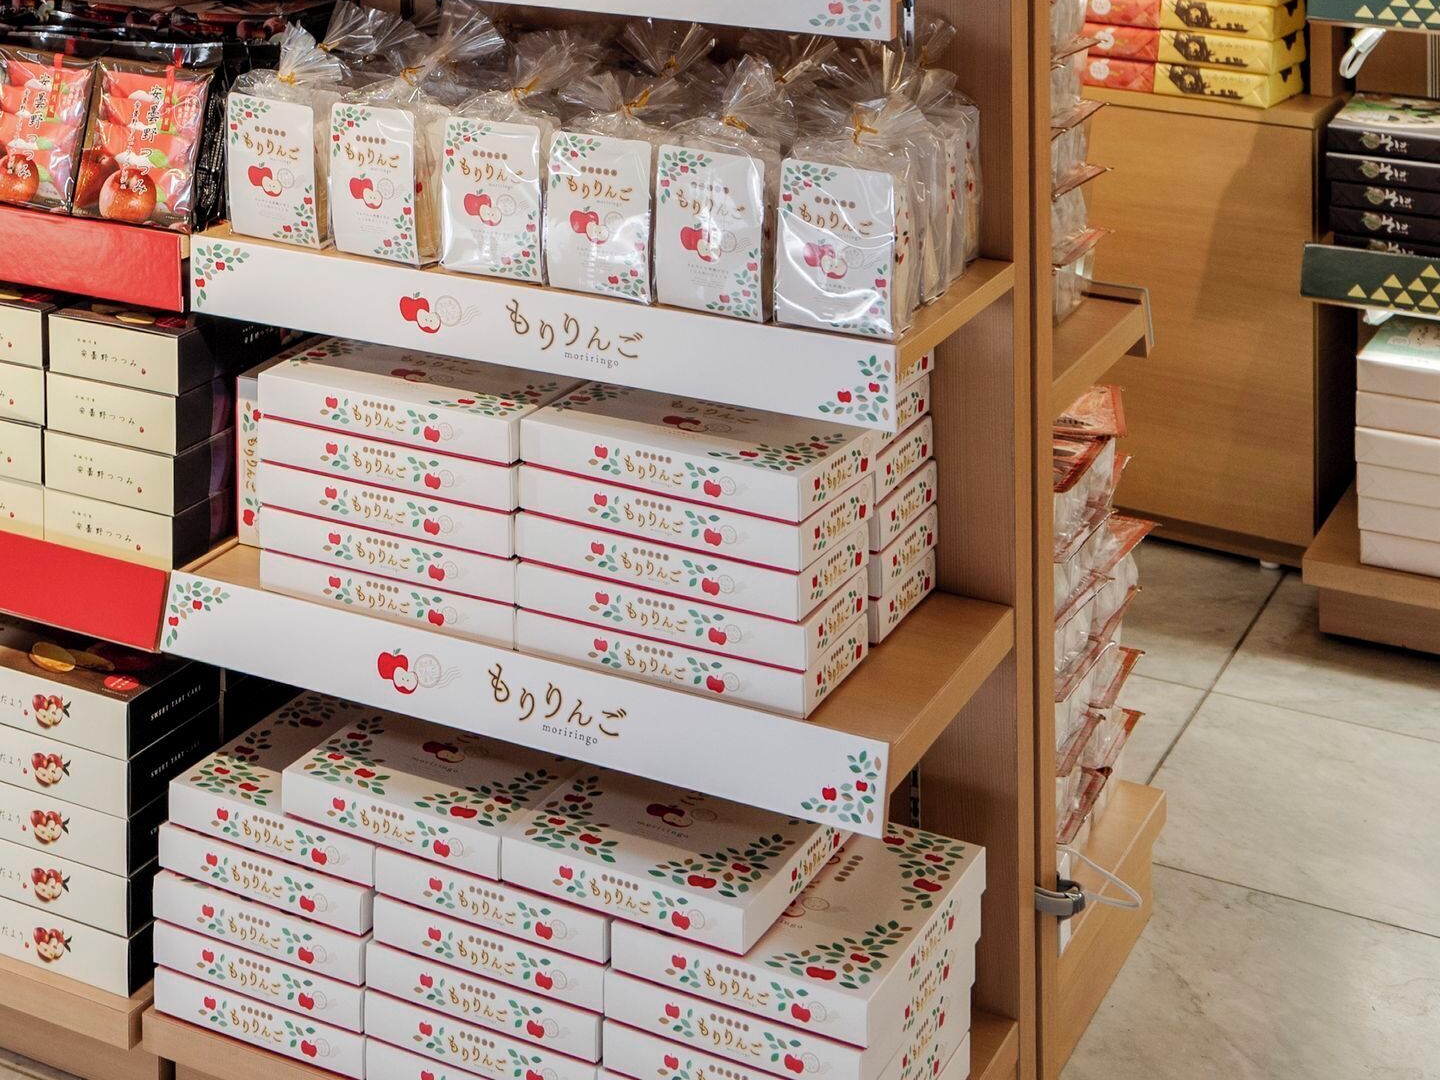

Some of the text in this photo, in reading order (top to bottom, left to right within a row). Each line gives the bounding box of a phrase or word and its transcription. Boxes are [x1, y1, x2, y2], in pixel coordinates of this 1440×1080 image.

[243, 132, 300, 161] もりりんご
[344, 142, 400, 170] もりりんご
[459, 156, 525, 184] もりりんご
[565, 176, 633, 202] もりりんご
[798, 203, 874, 236] もりりんご
[506, 298, 643, 359] もりりんご
[564, 350, 620, 369] moriringo
[352, 404, 406, 431] もりりんご
[353, 450, 407, 478] もりりんご
[624, 455, 684, 485] もりりんご
[352, 495, 406, 524] もりりんご
[624, 503, 684, 533] もりりんご
[621, 552, 682, 582] もりりんご
[150, 703, 170, 721] SWEET
[171, 694, 186, 712] TART
[488, 663, 627, 737] もりりんご
[542, 722, 599, 746] moriringo
[242, 818, 295, 852] もりりんご
[360, 808, 417, 843] もりりんご
[231, 865, 285, 898] もりりんご
[589, 878, 652, 915] もりりんご
[458, 889, 517, 925] もりりんご
[457, 939, 516, 975] もりりんご
[703, 967, 770, 1007] もりりんご
[697, 1016, 764, 1057] もりりんご
